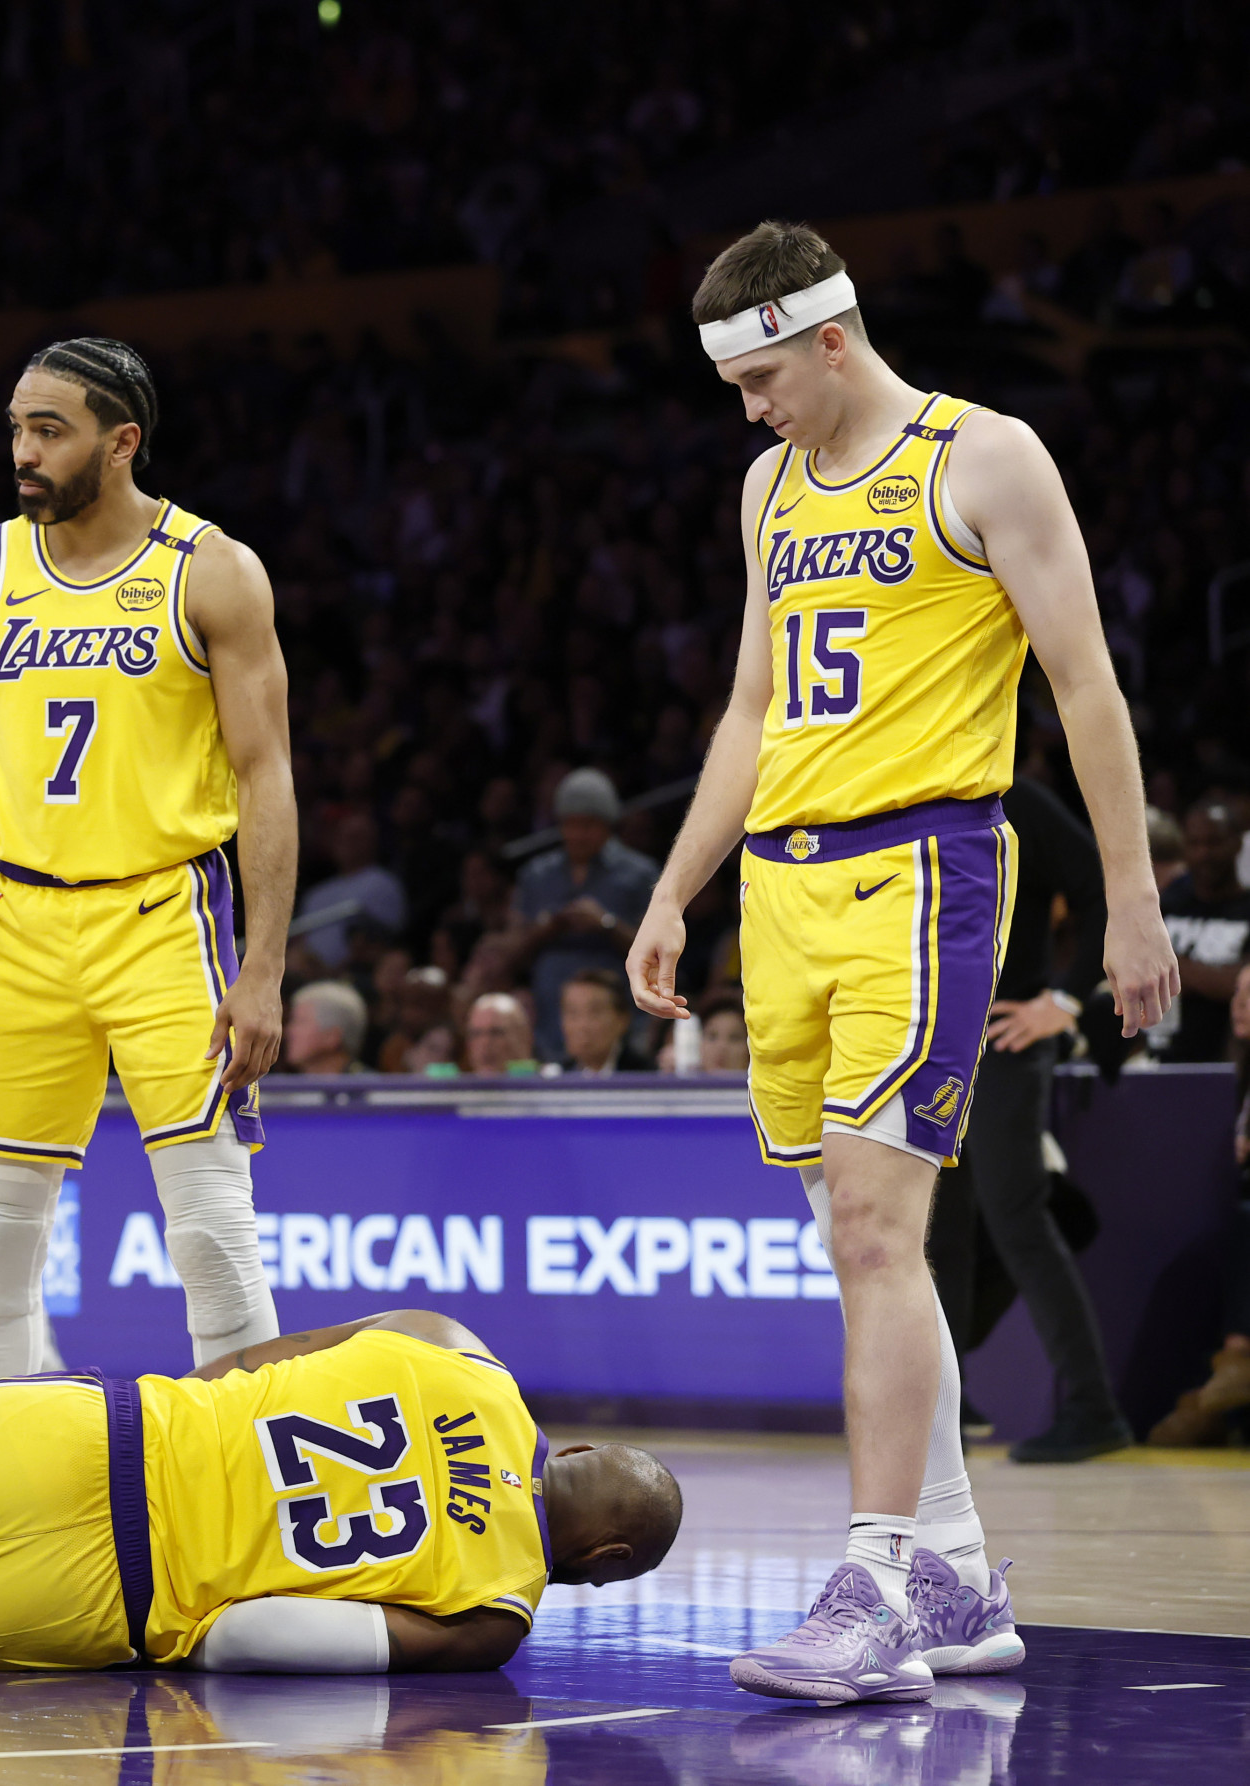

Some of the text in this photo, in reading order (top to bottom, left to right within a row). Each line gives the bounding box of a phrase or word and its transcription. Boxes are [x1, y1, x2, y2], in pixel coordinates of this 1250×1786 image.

[920, 428, 937, 439] 44
[872, 485, 917, 502] bibigo
[121, 587, 163, 601] bibigo
[767, 525, 917, 605] LAKERS
[783, 608, 868, 729] 15
[44, 698, 98, 804] 7
[786, 836, 819, 853] LAKERS
[109, 1212, 503, 1293] AERICAN
[526, 1215, 841, 1299] EXPRES
[253, 1392, 432, 1574] 23
[433, 1411, 492, 1536] JAMES
